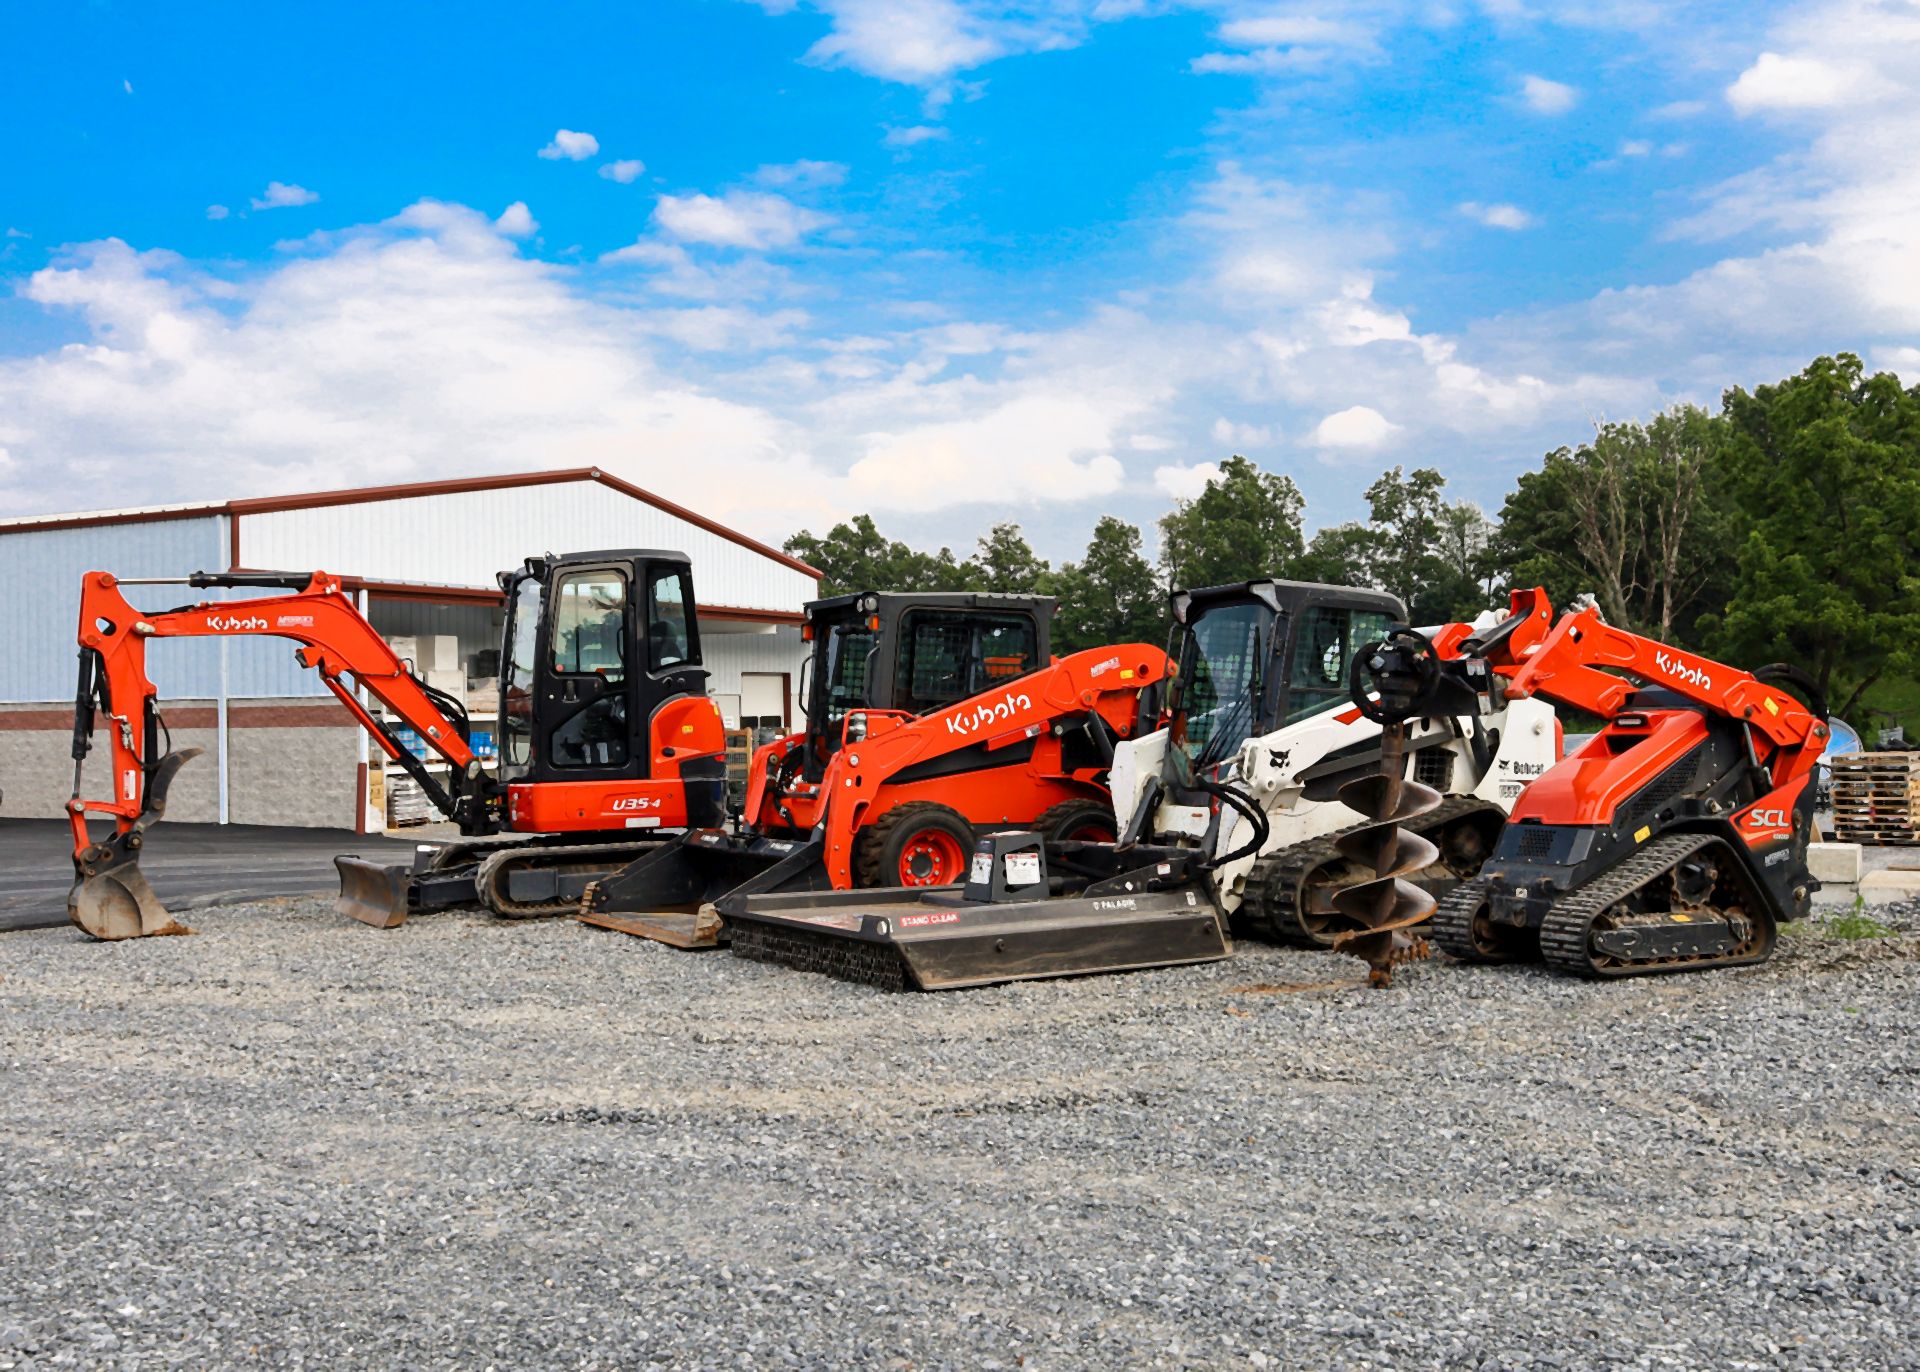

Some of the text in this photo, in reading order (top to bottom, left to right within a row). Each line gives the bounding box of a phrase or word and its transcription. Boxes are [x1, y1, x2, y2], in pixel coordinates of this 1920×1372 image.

[206, 616, 268, 630] Kubota
[1655, 650, 1711, 690] Kubota
[945, 693, 1032, 735] Kubota
[1749, 809, 1789, 827] SCL
